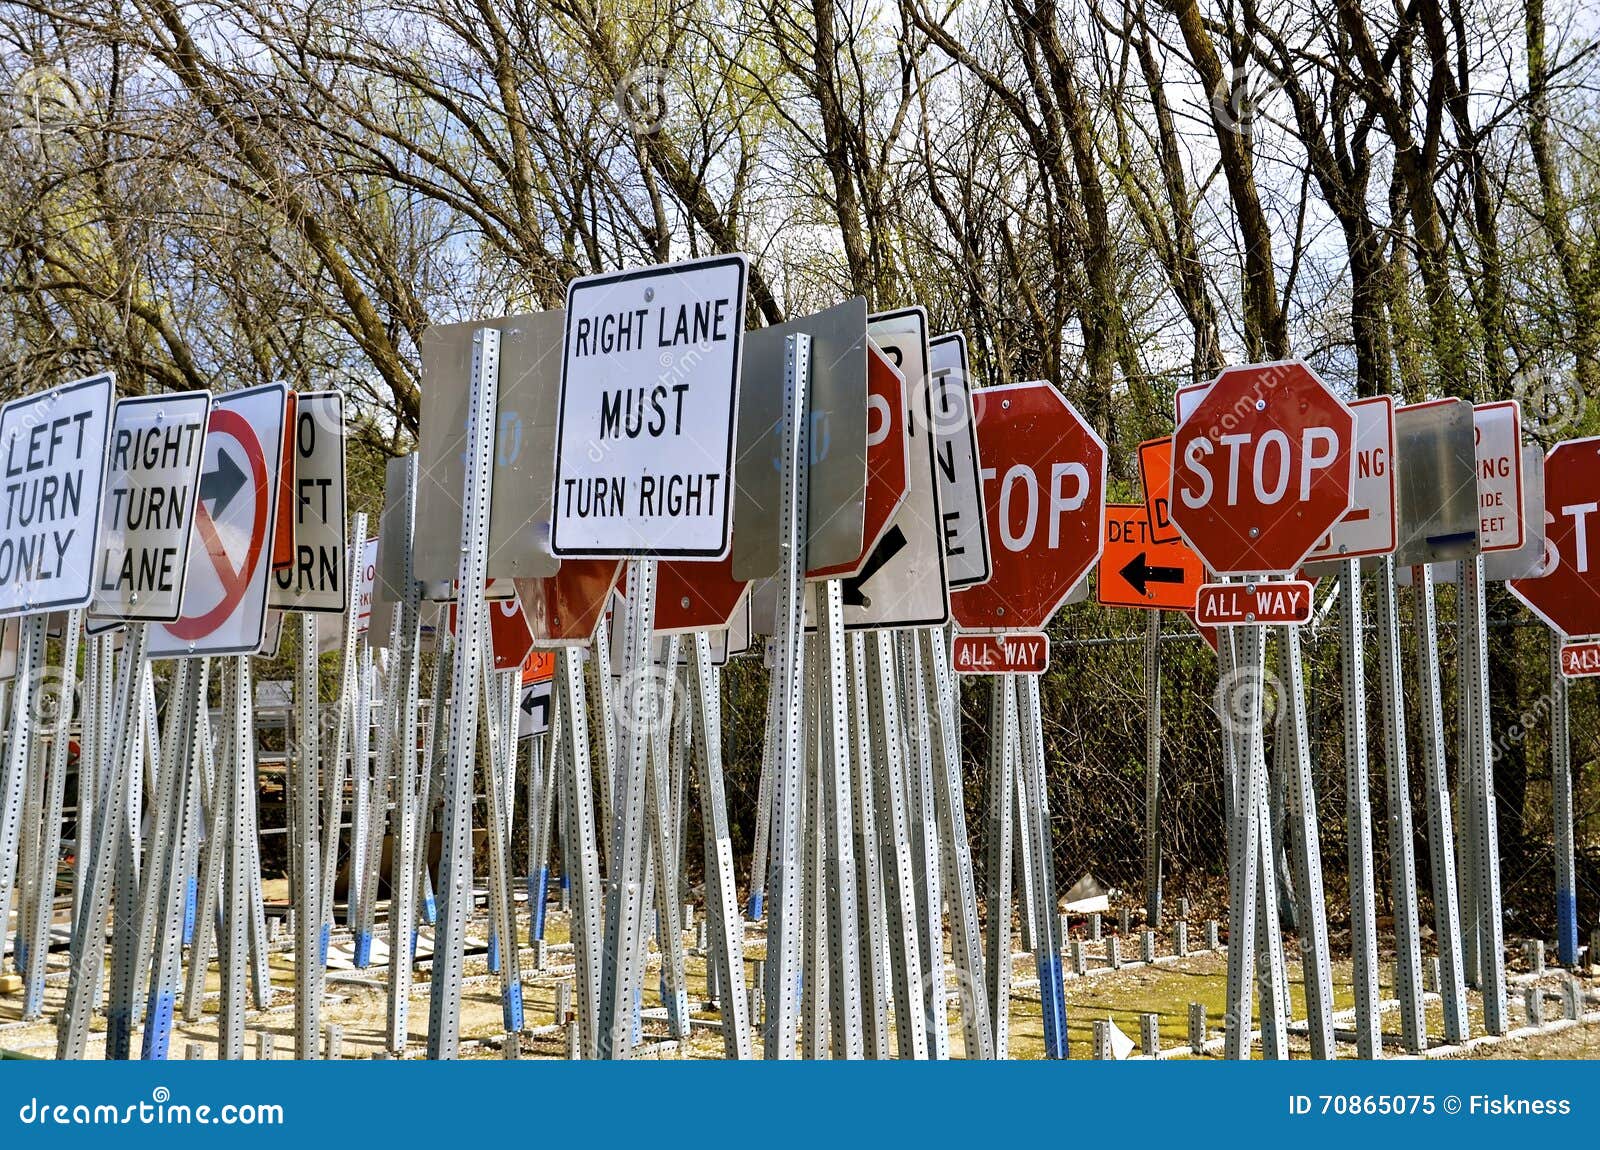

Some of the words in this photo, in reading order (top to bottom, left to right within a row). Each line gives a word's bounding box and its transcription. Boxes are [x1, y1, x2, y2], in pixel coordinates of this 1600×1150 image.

[576, 309, 649, 357] RIGHT
[658, 298, 729, 348] LANE
[600, 384, 689, 440] MUST
[6, 410, 93, 478] LEFT
[112, 423, 200, 472] RIGHT
[1181, 426, 1340, 509] STOP
[6, 469, 84, 530] TURN
[112, 485, 188, 531] TURN
[564, 476, 626, 518] TURN
[639, 473, 720, 517] RIGHT
[0, 529, 75, 586] ONLY
[101, 547, 177, 592] LANE
[1205, 592, 1243, 617] ALL
[1256, 591, 1301, 615] WAY
[960, 643, 992, 665] ALL
[1004, 642, 1039, 665] WAY
